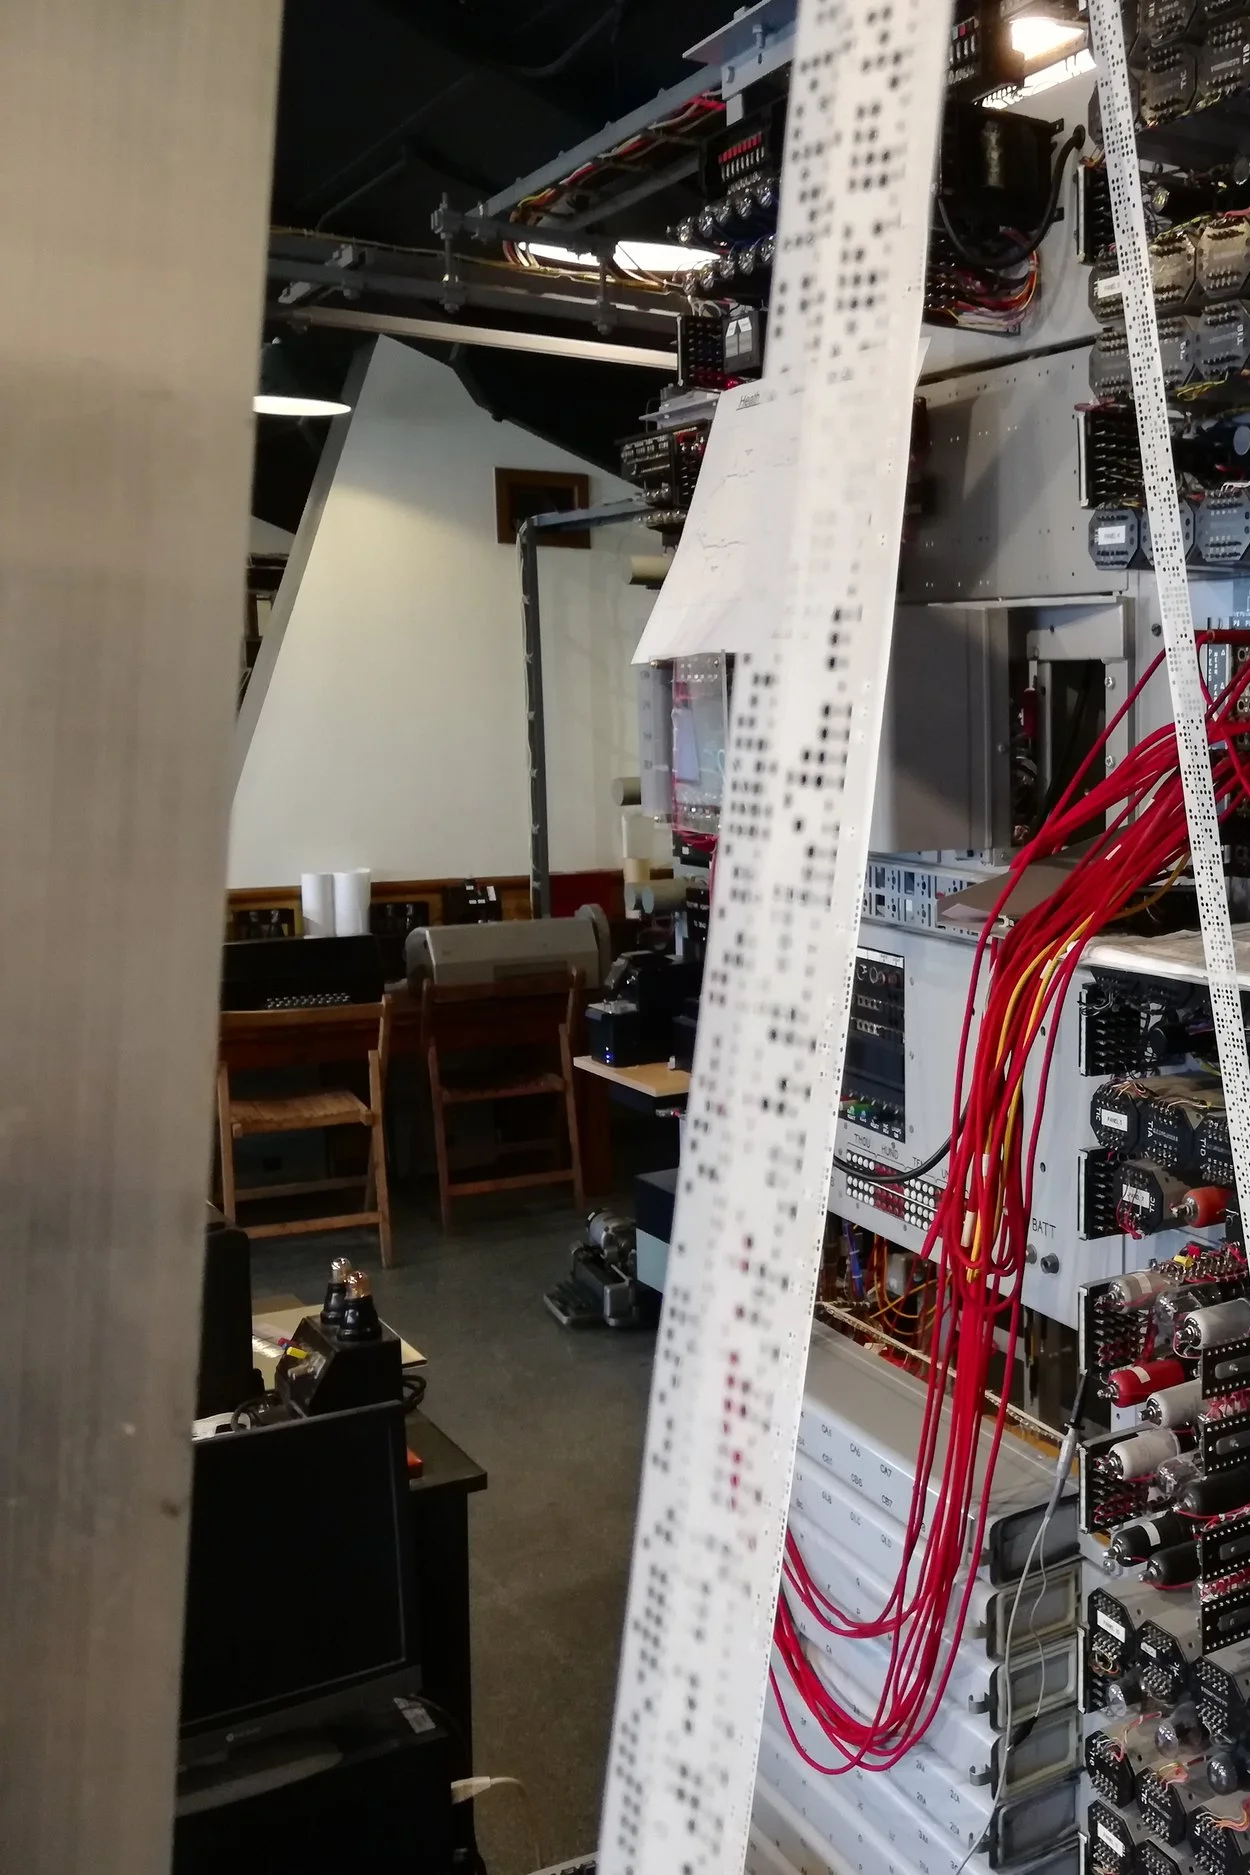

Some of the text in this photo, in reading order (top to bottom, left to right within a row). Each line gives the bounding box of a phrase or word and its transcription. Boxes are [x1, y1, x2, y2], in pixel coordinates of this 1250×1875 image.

[854, 1132, 871, 1149] THOU
[881, 1145, 898, 1160] HUND
[1032, 1217, 1057, 1239] BATT
[880, 1464, 893, 1478] CA7
